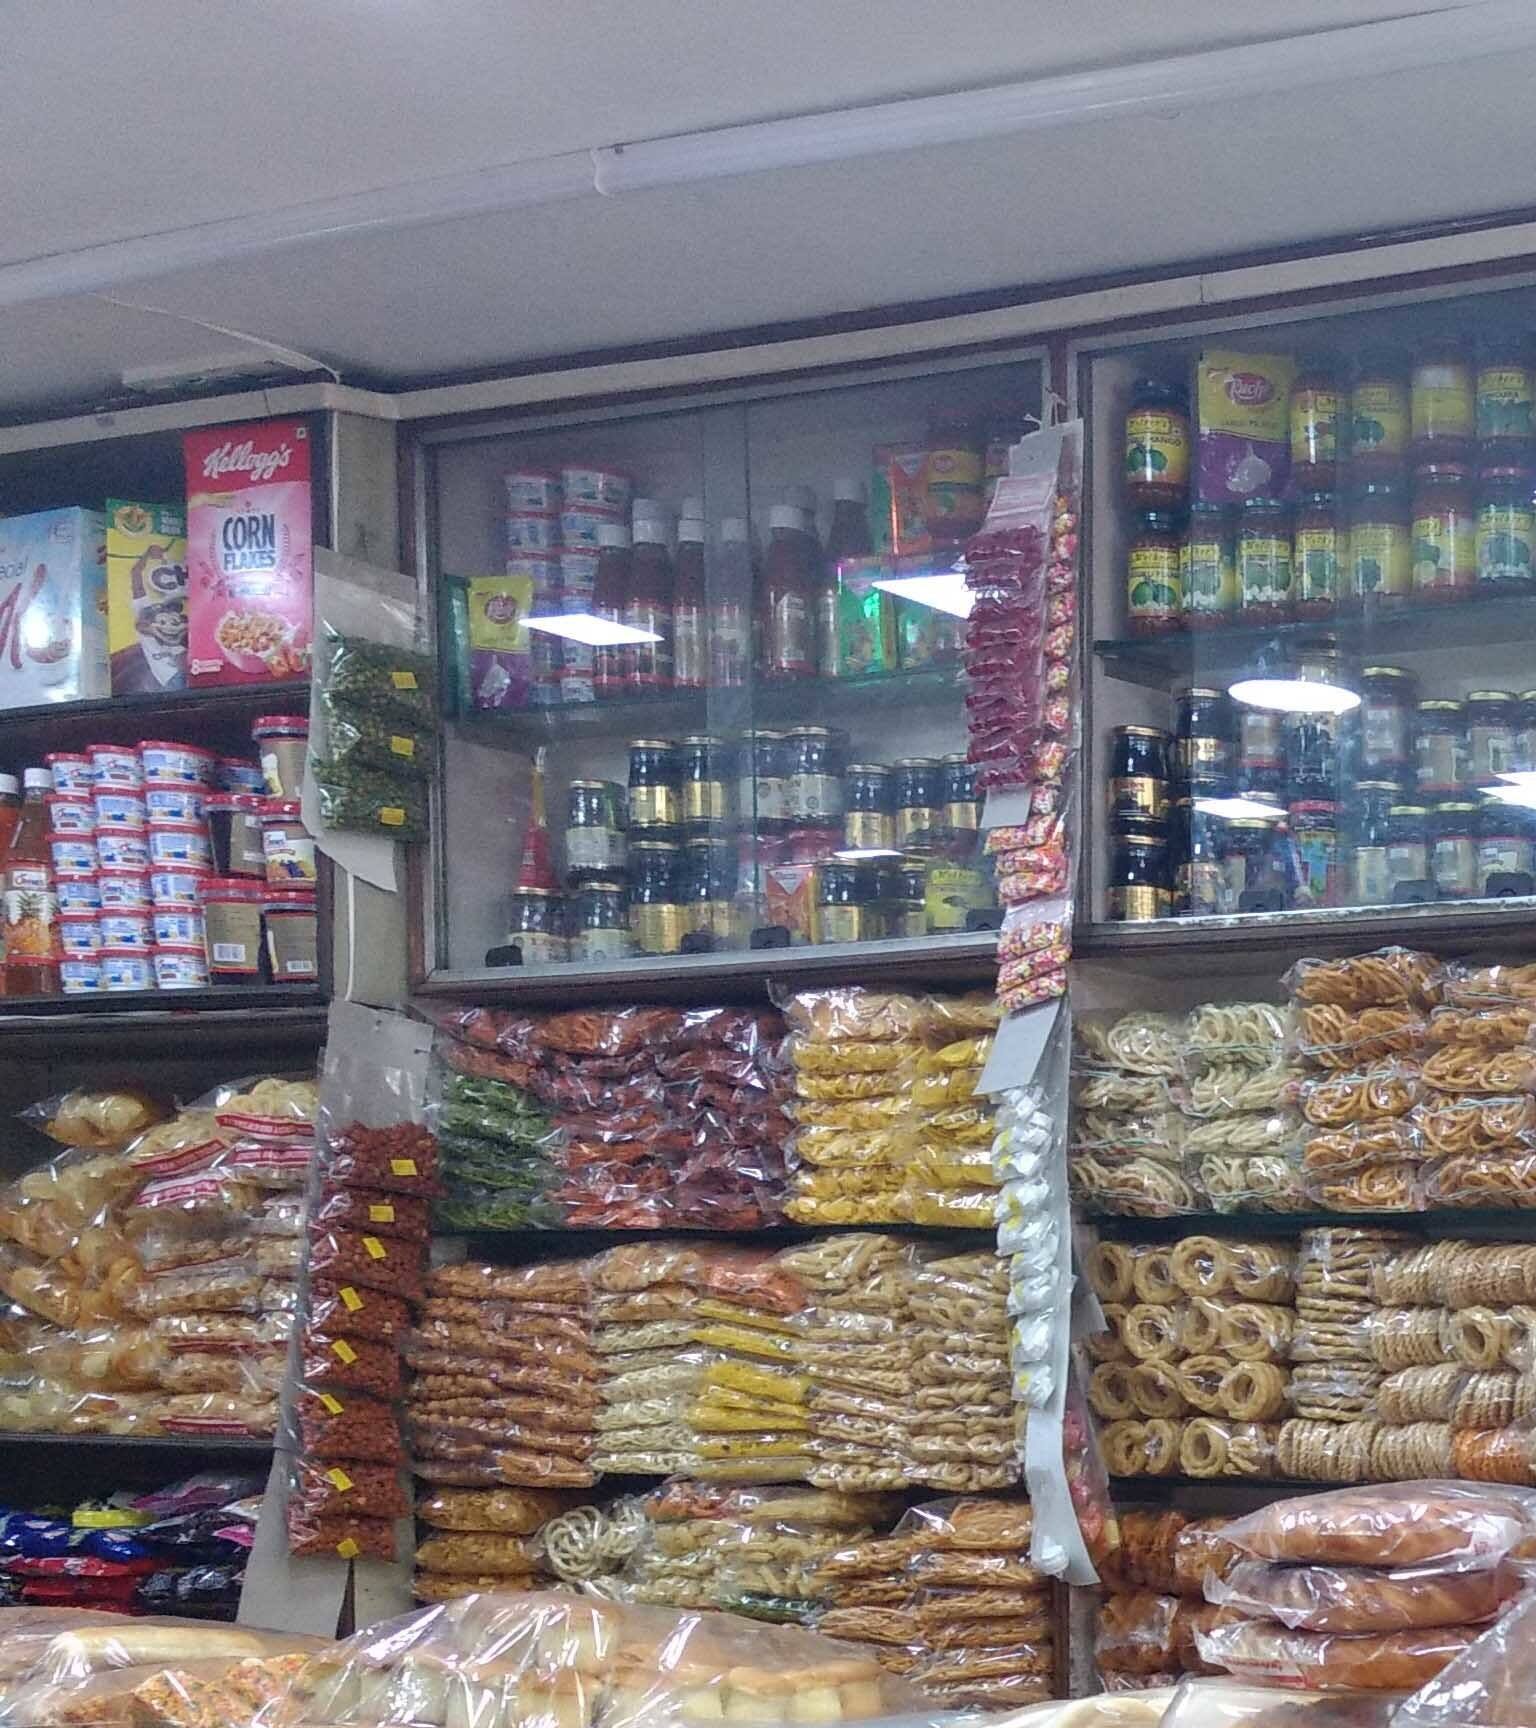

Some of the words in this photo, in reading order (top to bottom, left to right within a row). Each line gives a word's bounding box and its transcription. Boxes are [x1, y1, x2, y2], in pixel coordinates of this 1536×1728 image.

[202, 441, 294, 481] Kellogg's
[223, 513, 276, 550] CORN
[223, 550, 277, 572] FLAKES
